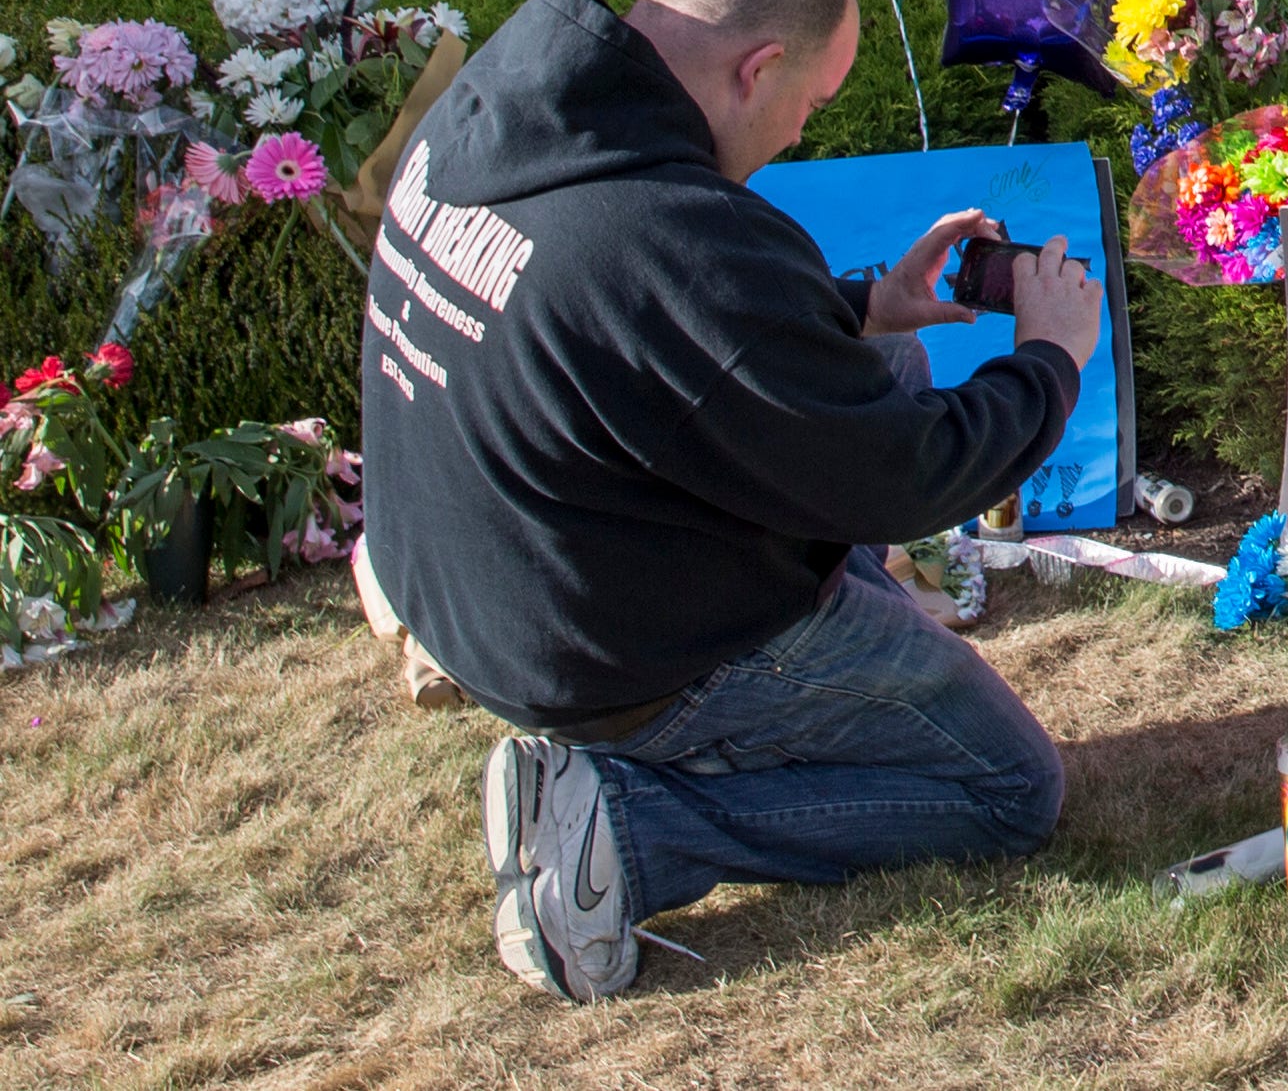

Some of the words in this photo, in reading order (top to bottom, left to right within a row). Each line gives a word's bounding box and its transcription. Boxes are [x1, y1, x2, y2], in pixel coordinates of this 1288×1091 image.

[420, 201, 536, 313] BREAKING
[412, 271, 486, 343] Awareness
[391, 319, 448, 389] Prevention
